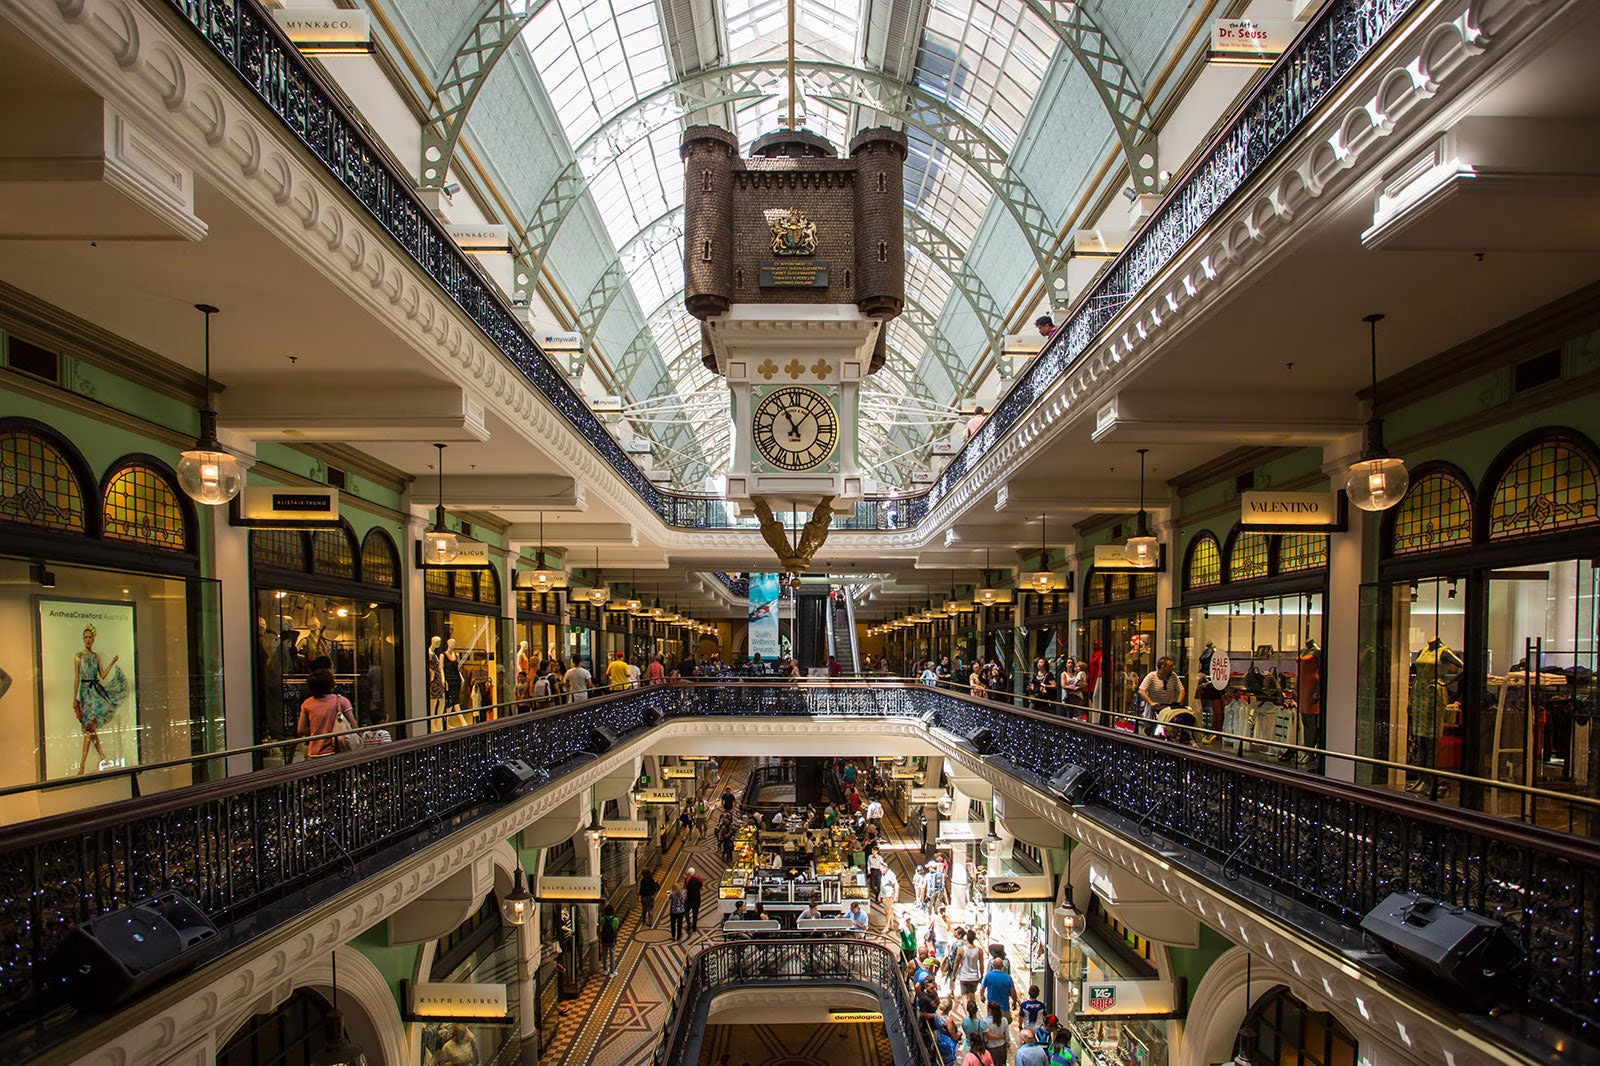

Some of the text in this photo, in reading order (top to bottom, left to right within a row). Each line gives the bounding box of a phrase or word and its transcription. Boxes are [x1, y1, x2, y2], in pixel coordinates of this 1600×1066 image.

[1219, 28, 1267, 39] Dr. Seuss
[1250, 501, 1319, 513] VALENTINO
[49, 610, 102, 619] AntheaCrawford
[1212, 658, 1228, 667] SALE
[1212, 668, 1228, 681] 70%
[1094, 989, 1111, 998] TAG
[1092, 999, 1114, 1010] HEUER
